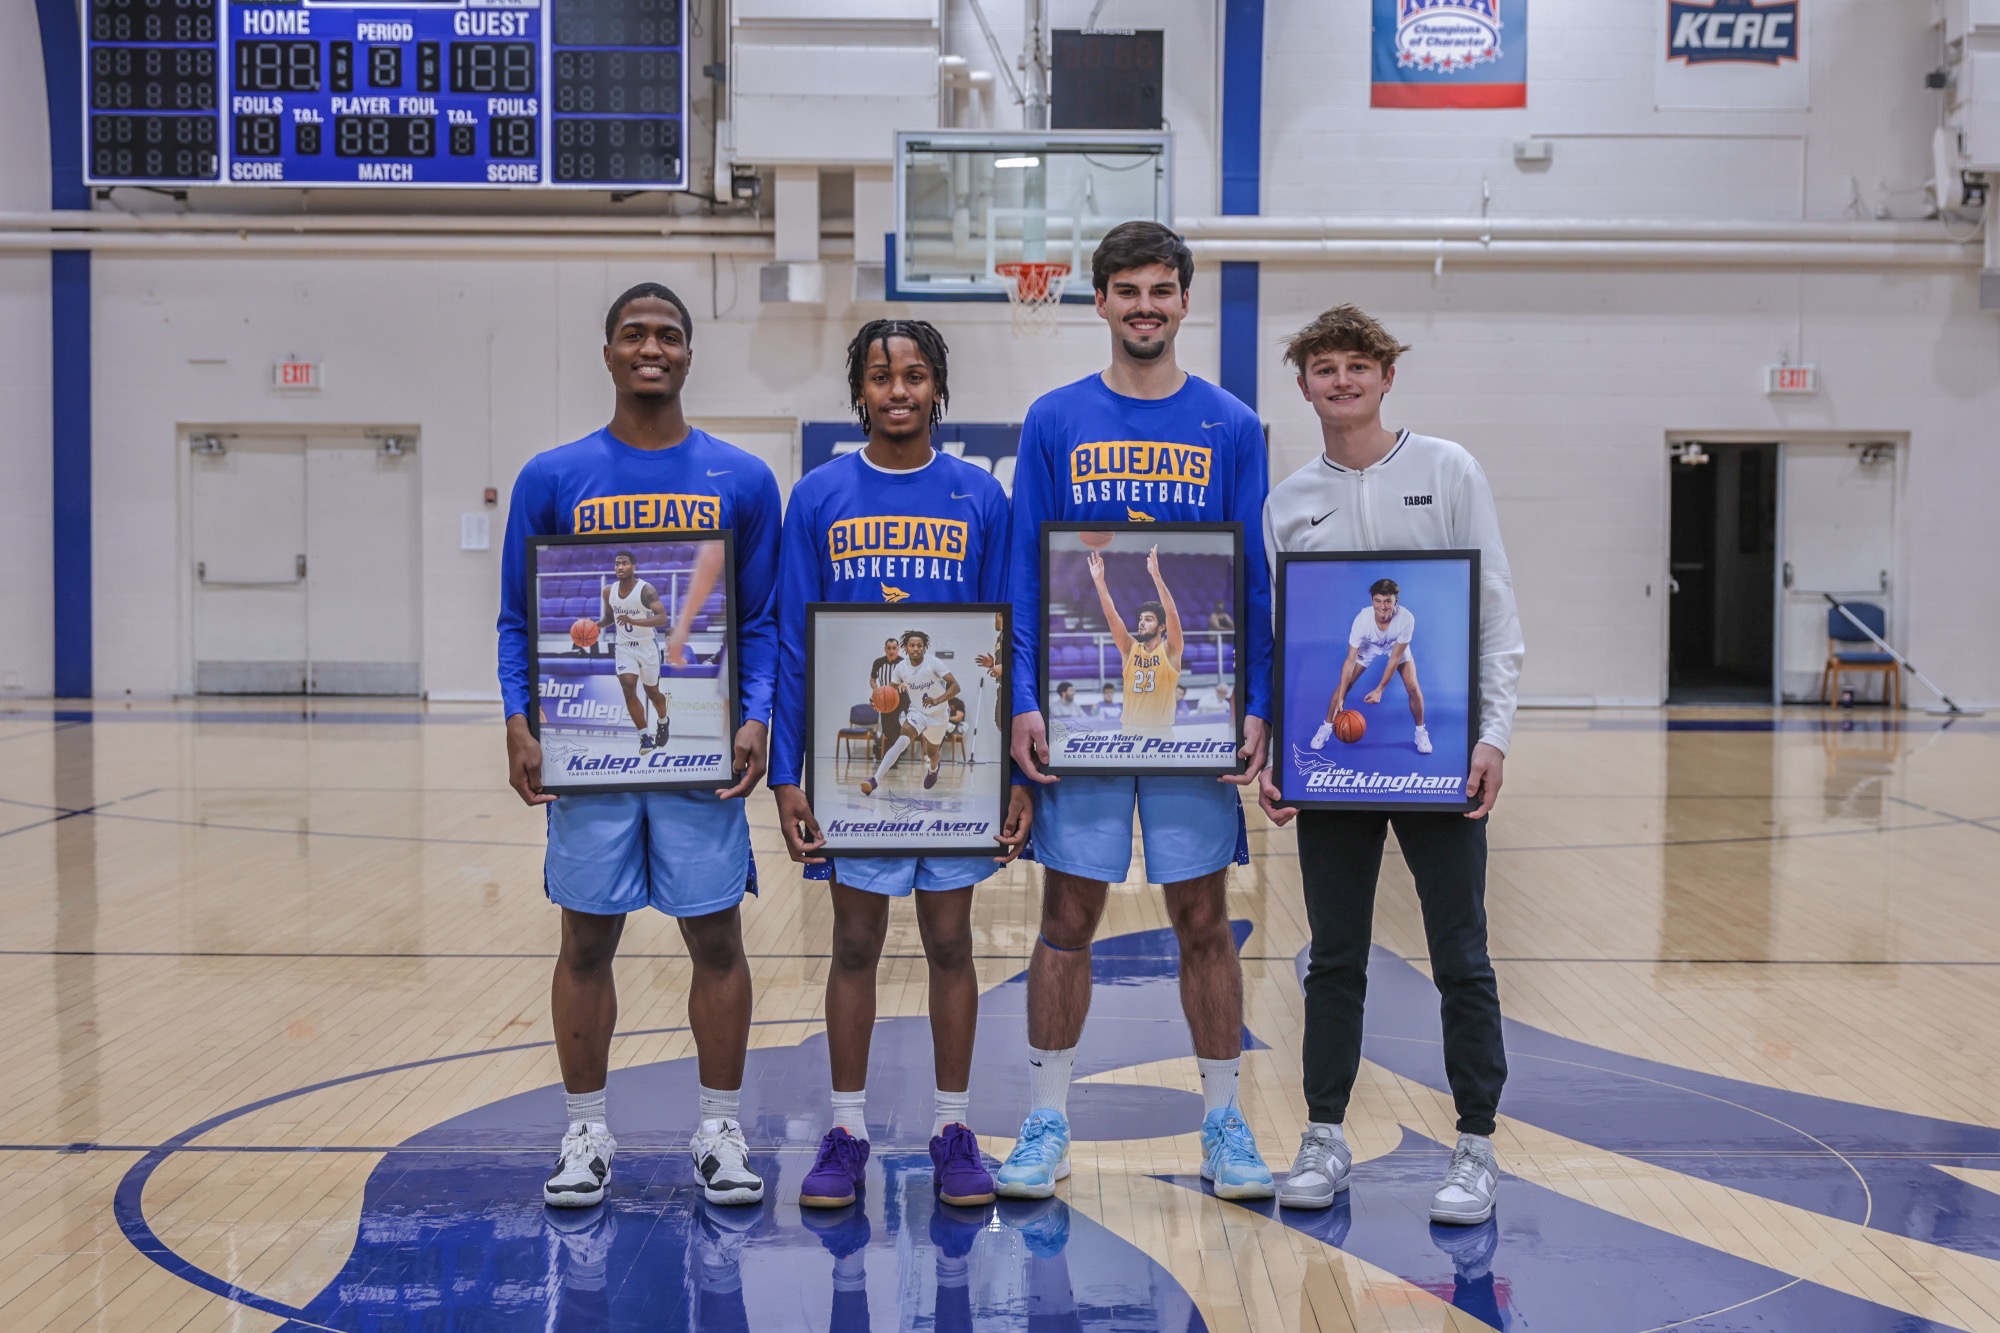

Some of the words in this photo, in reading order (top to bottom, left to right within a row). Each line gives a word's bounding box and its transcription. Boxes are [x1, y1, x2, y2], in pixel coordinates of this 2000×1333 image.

[243, 10, 310, 35] HOME
[357, 23, 413, 41] PERIOD
[454, 11, 529, 36] GUEST
[1414, 24, 1481, 35] Champions
[1672, 12, 1794, 49] KCAC
[1409, 37, 1422, 47] of
[1426, 37, 1485, 47] Character
[233, 97, 283, 114] FOULS
[331, 97, 390, 115] PLAYER
[399, 97, 439, 115] FOUL
[487, 98, 538, 115] FOULS
[232, 162, 283, 180] SCORE
[358, 163, 413, 181] MATCH
[487, 164, 538, 182] SCORE
[282, 362, 311, 385] EXIT
[1779, 367, 1808, 390] EXIT
[1076, 446, 1207, 480] BLUEJAYS
[1072, 481, 1206, 507] BASKETBALL
[1403, 495, 1433, 506] TABOR
[579, 499, 717, 532] BLUEJAYS
[832, 520, 964, 555] BLUEJAYS
[833, 556, 964, 582] BASKETBALL
[1133, 670, 1155, 693] 23
[1064, 738, 1135, 753] Serra
[1142, 738, 1237, 753] Pereira
[566, 754, 641, 773] Kalep
[648, 752, 723, 768] Crane
[1327, 767, 1354, 776] Luke
[1306, 772, 1462, 792] Buckingham
[827, 820, 924, 832] Kreeland
[927, 820, 989, 834] Avery
